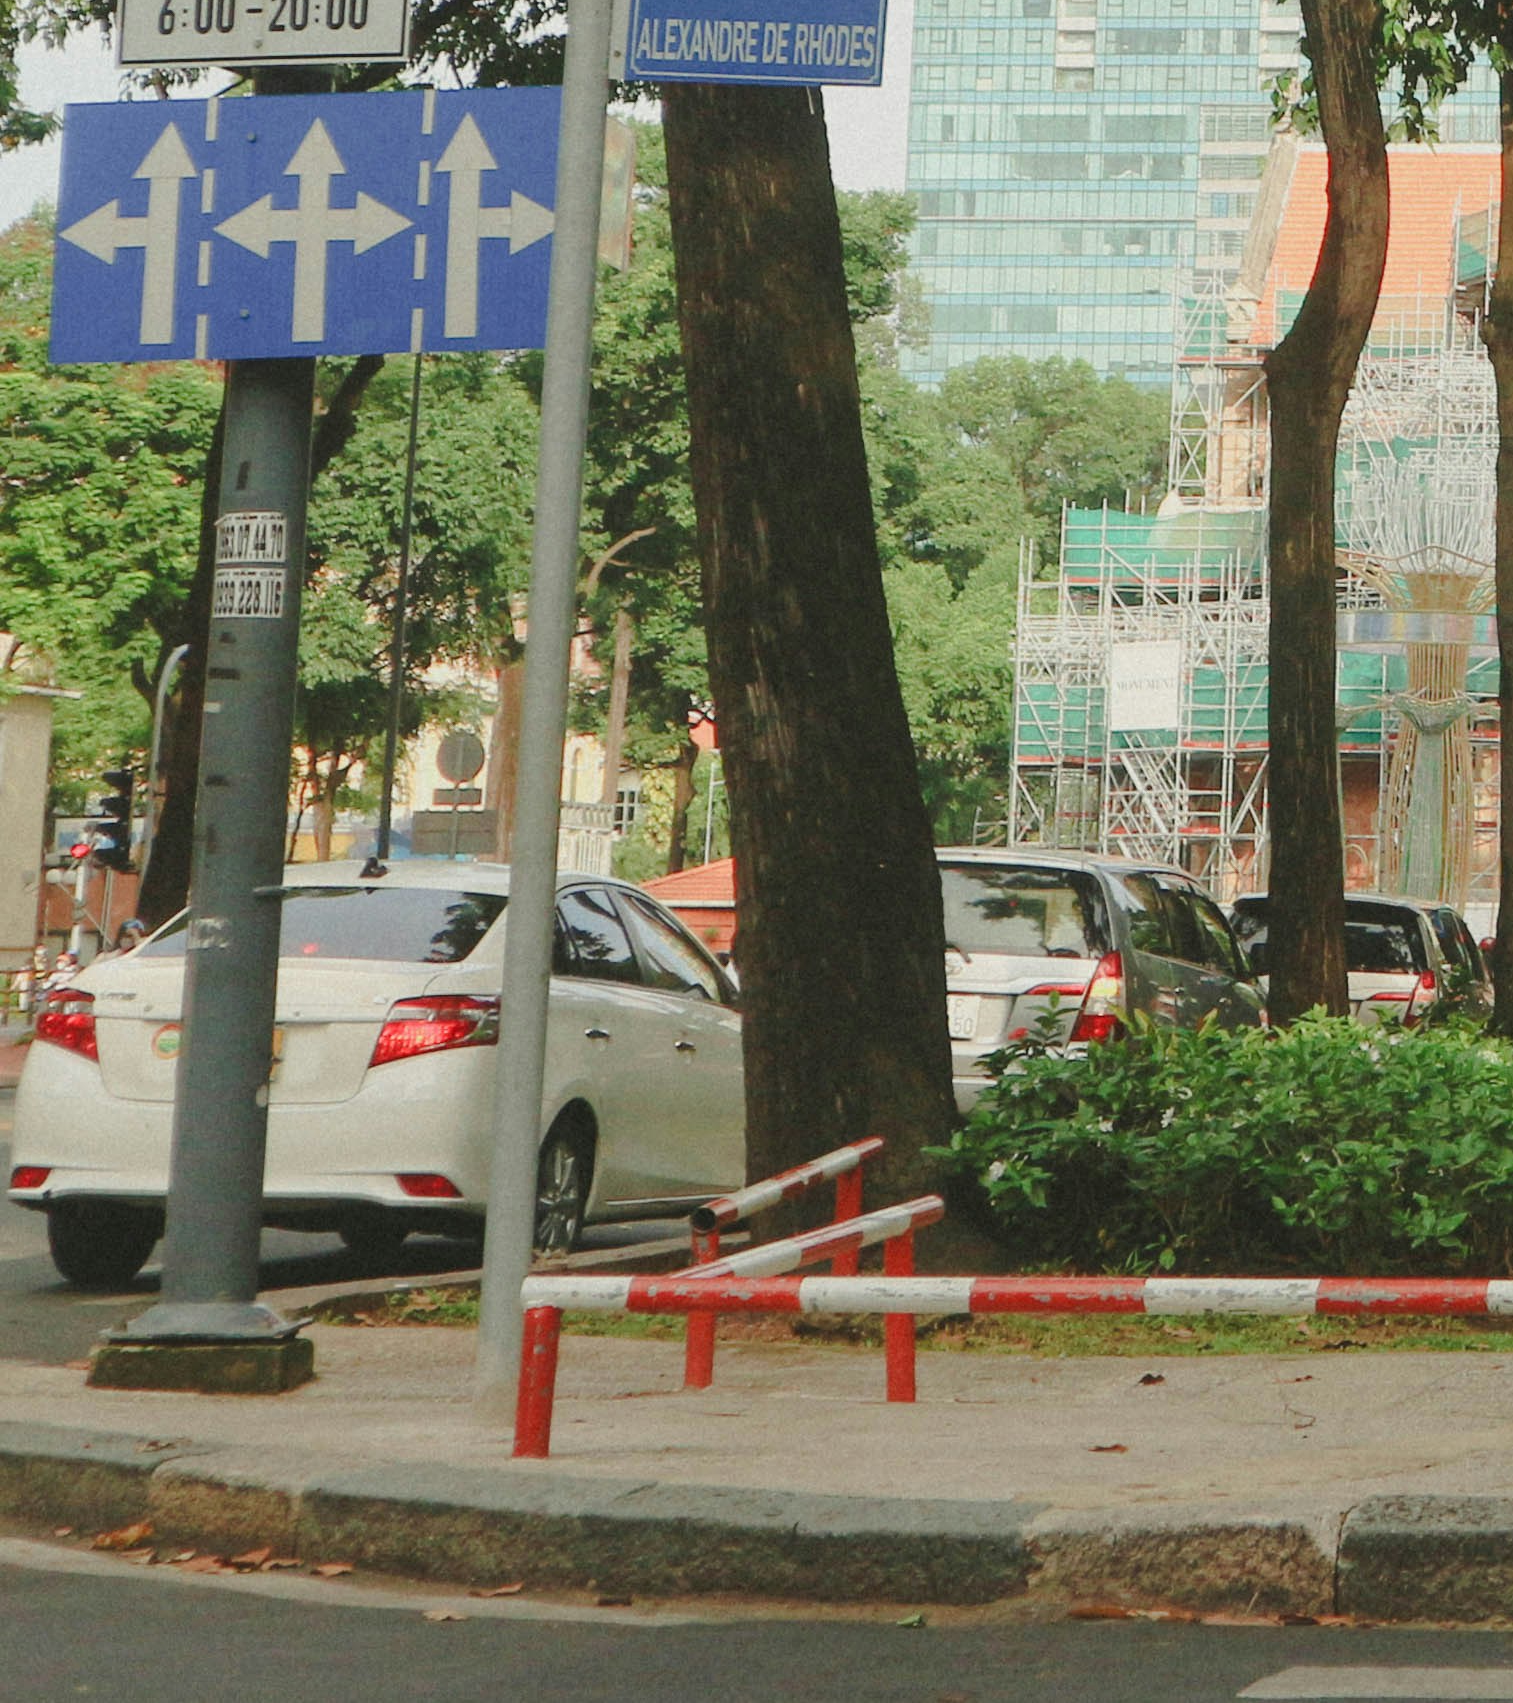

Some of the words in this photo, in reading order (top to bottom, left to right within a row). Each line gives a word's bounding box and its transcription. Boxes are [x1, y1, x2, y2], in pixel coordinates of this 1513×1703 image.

[636, 17, 759, 64] ALEXANDRE
[762, 21, 790, 65] DE
[793, 24, 877, 67] RHODES
